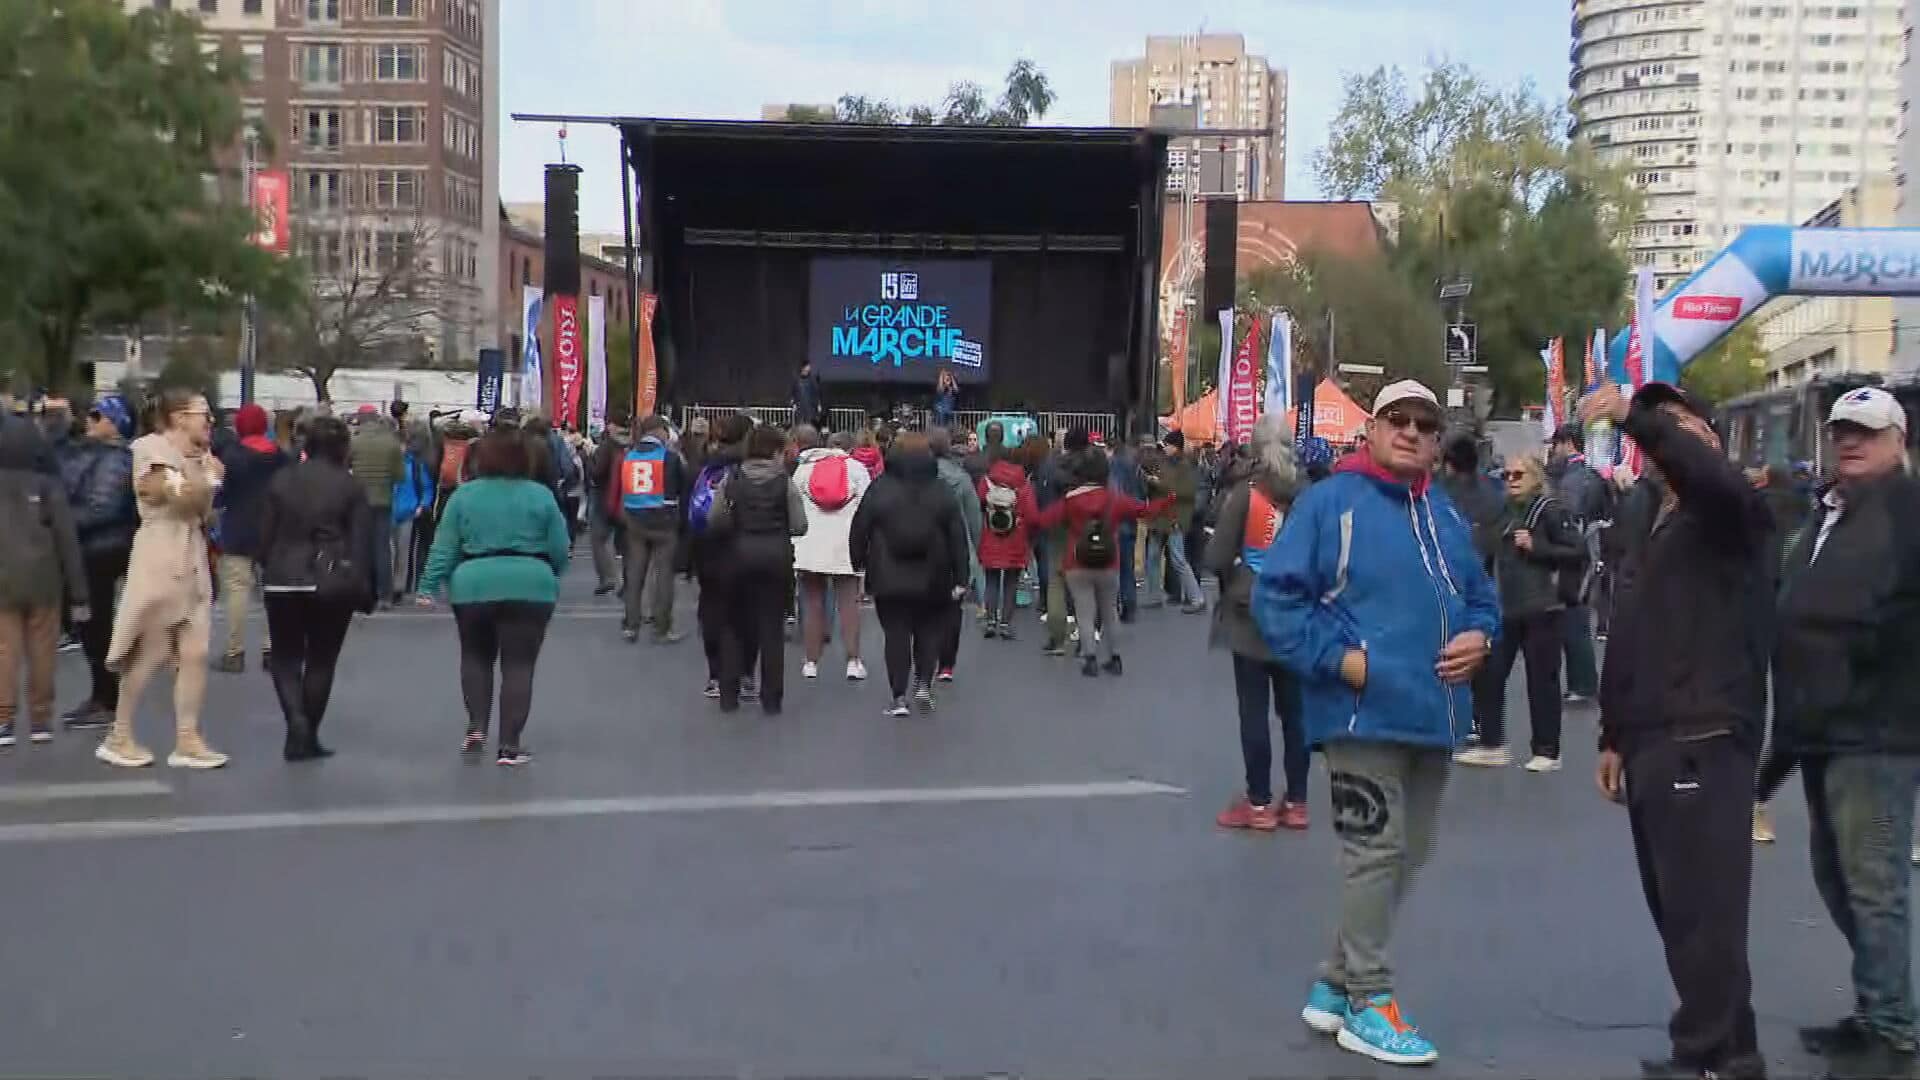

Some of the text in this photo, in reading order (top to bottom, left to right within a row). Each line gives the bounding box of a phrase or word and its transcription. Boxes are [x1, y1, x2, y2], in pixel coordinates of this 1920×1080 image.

[881, 272, 898, 300] 15
[862, 304, 949, 328] GRANDE
[632, 461, 653, 493] B
